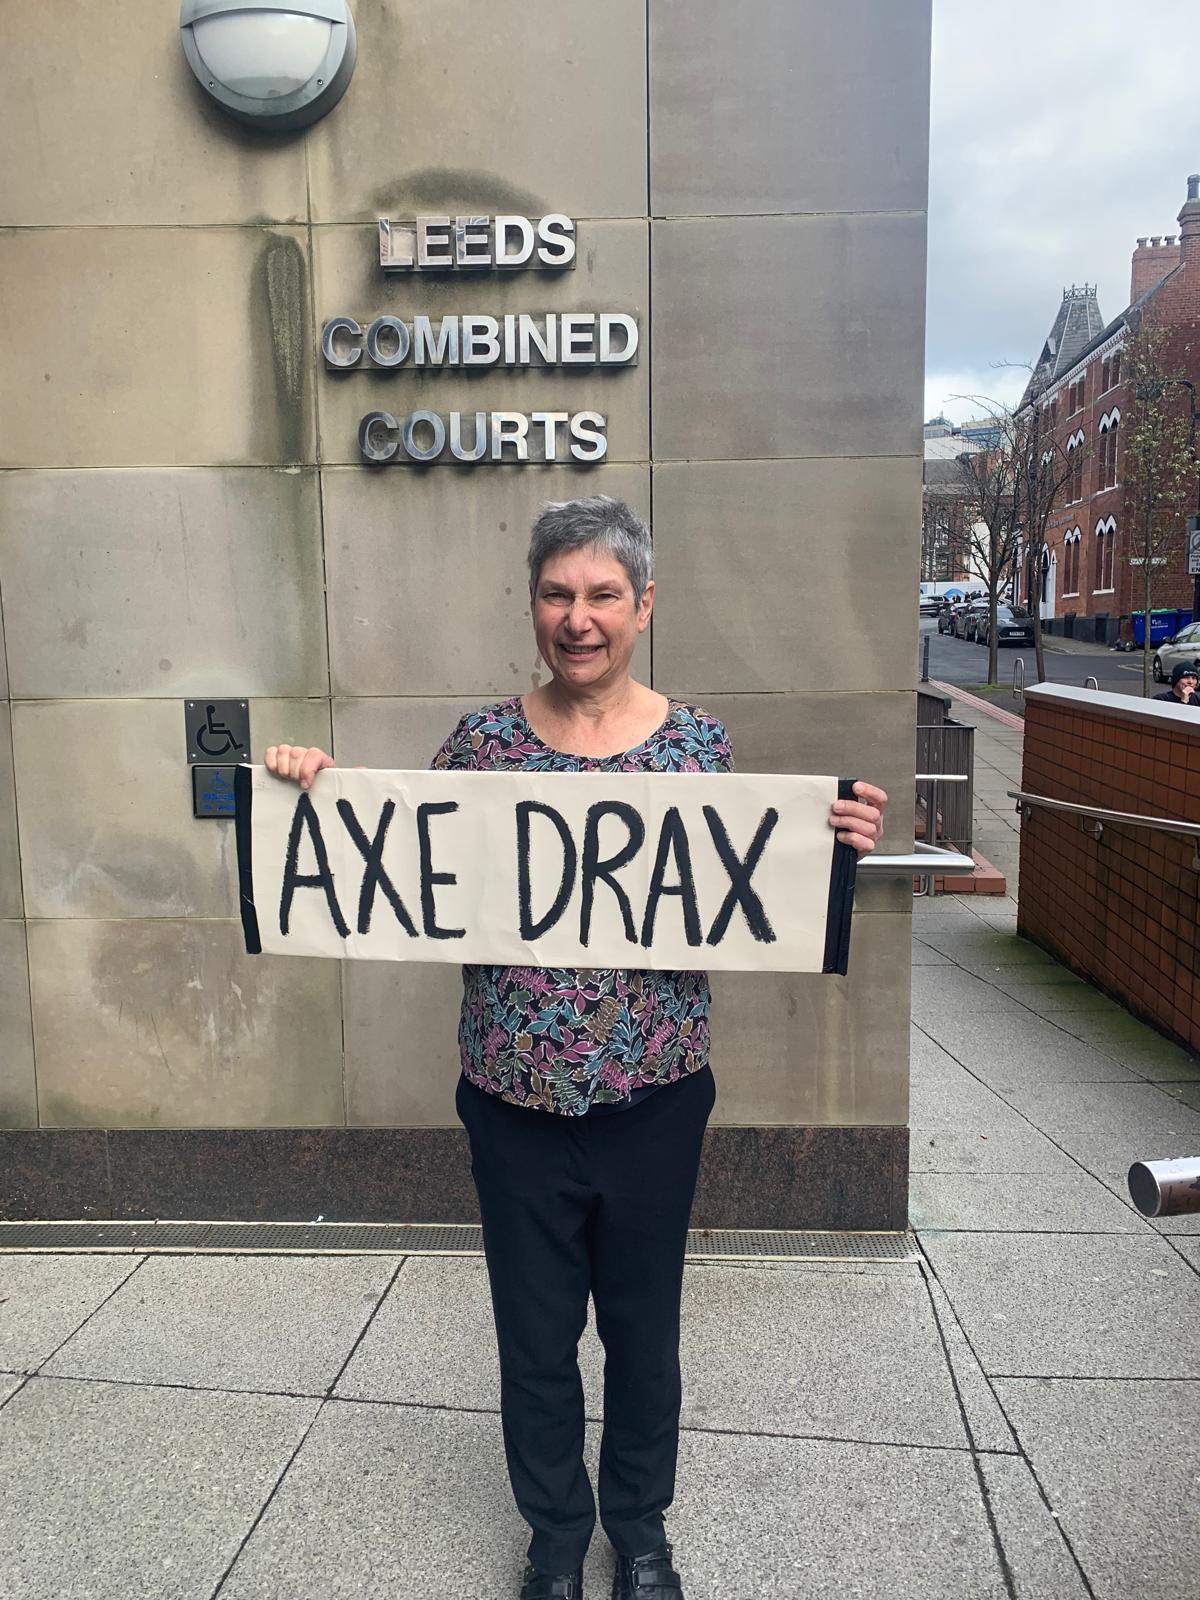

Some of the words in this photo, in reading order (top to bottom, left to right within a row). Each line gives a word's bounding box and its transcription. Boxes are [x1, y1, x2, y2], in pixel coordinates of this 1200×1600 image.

[378, 213, 575, 267] LEEDS
[322, 313, 638, 367] COMBINED
[358, 411, 607, 461] COURTS
[280, 792, 467, 939] AXE
[515, 800, 779, 948] DRAX
